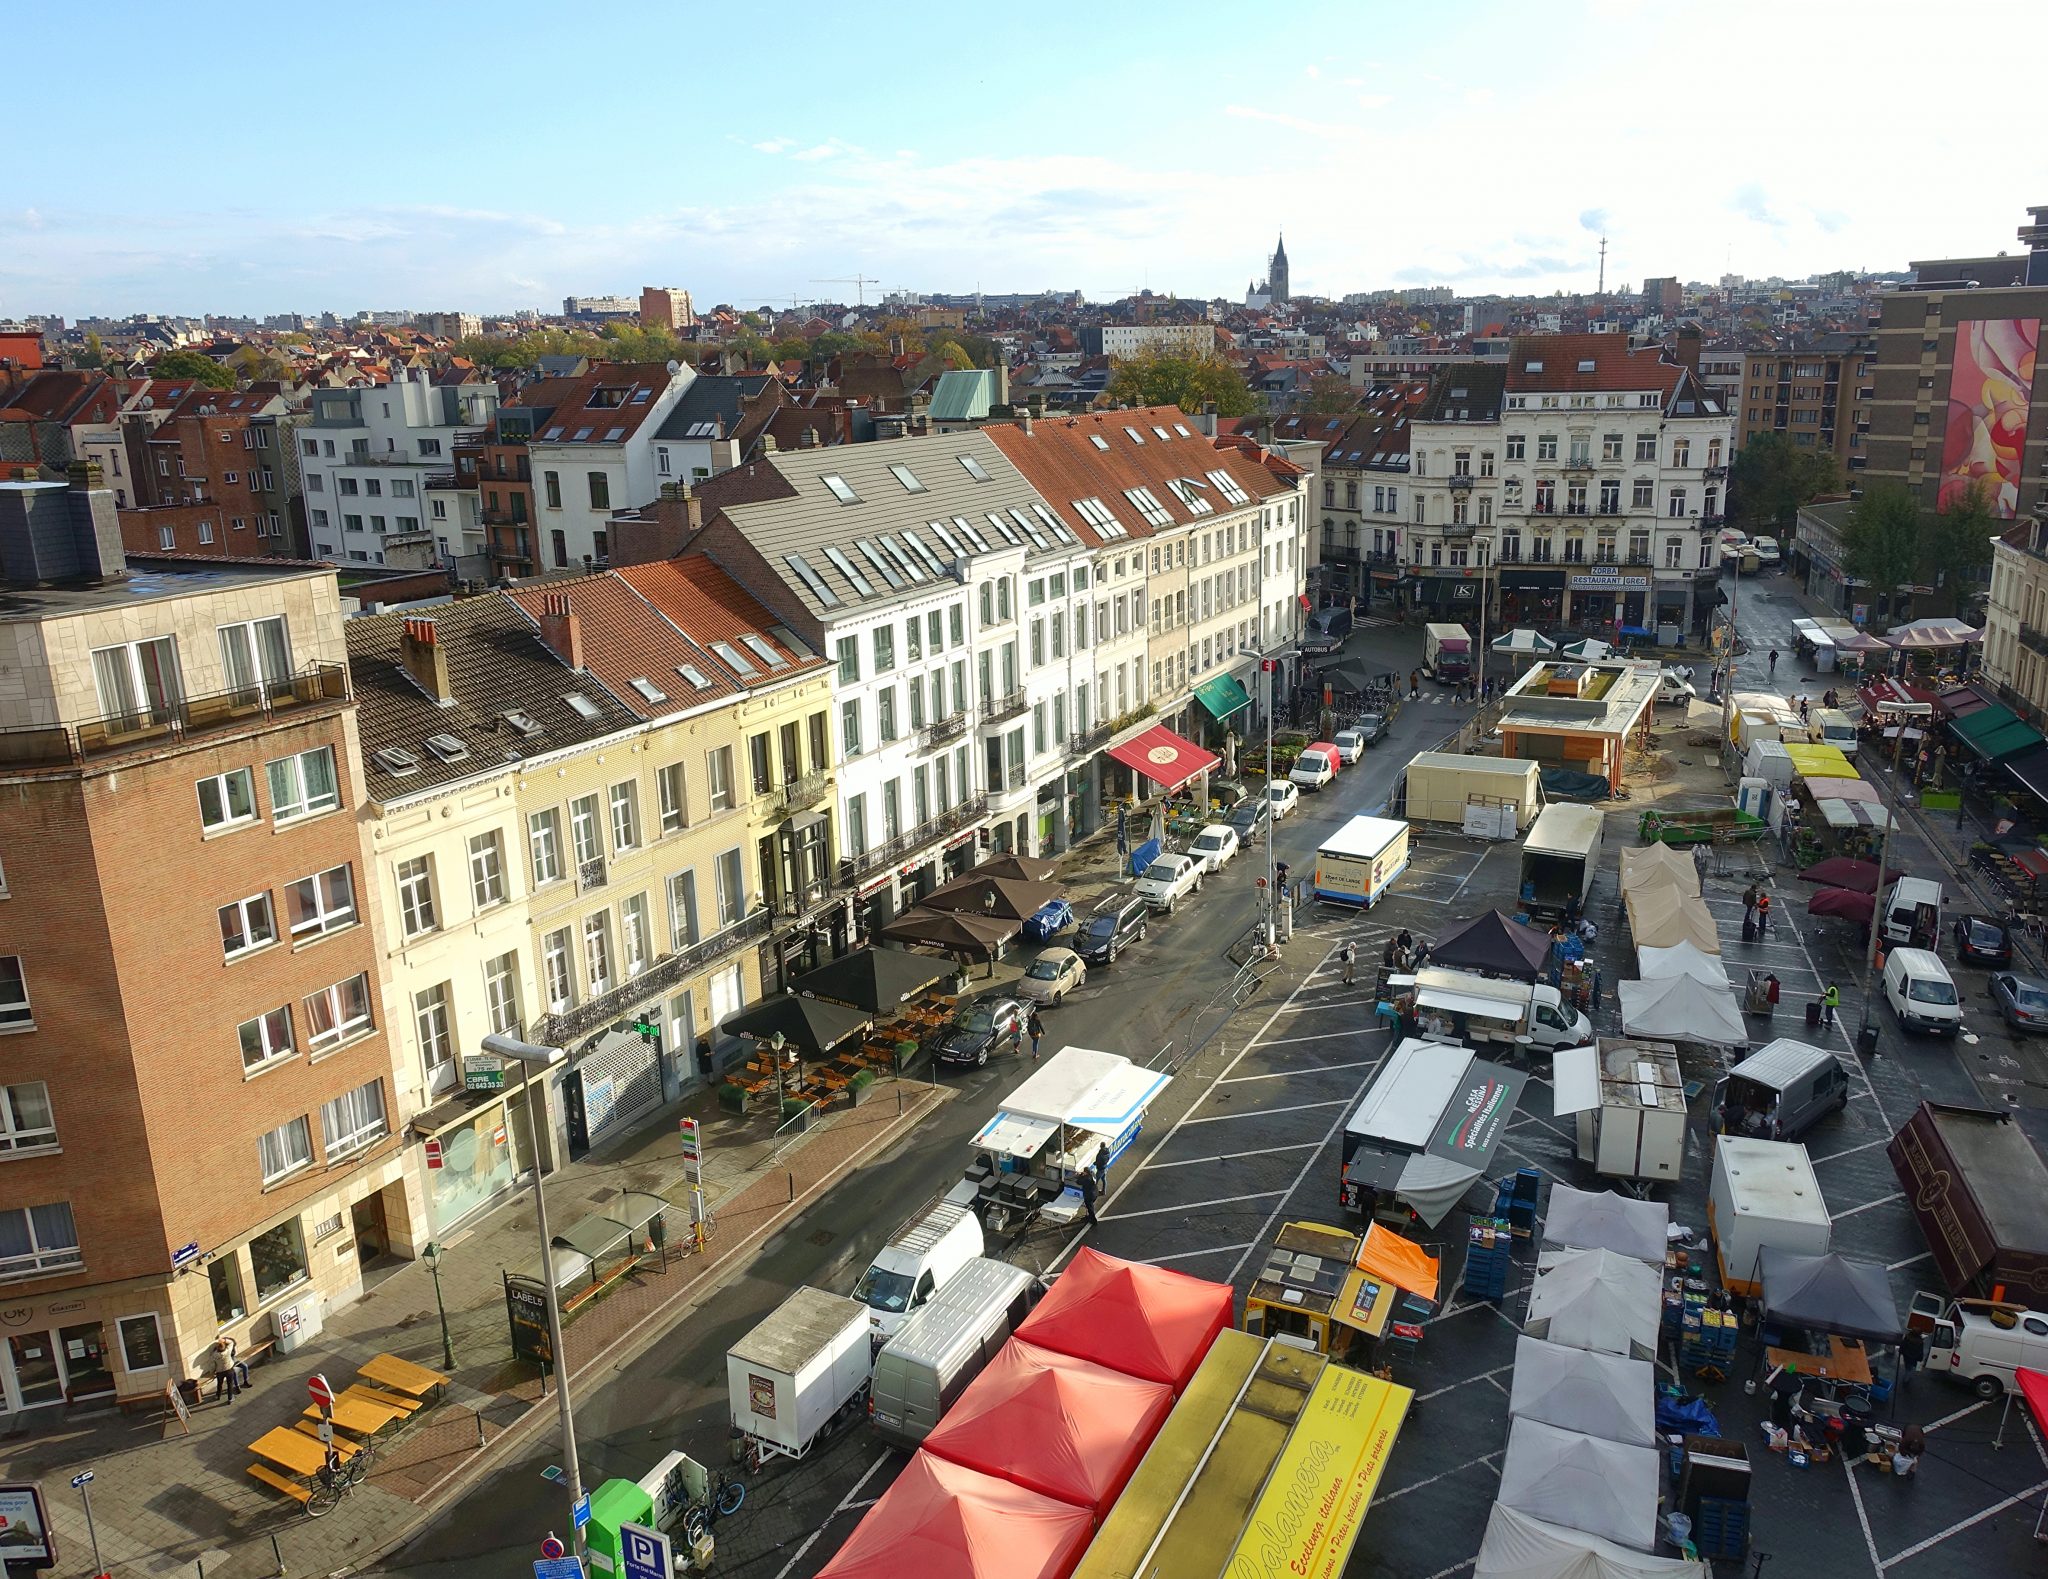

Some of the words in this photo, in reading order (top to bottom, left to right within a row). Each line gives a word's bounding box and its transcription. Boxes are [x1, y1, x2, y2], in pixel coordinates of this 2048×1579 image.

[1572, 577, 1622, 585] RESTAURANT
[1625, 577, 1646, 585] GREC
[1592, 567, 1617, 575] ZORBA
[905, 852, 940, 875] PAMPAS
[920, 939, 945, 948] PAMPAS
[1465, 1089, 1479, 1106] CASA
[1467, 1085, 1487, 1114] MESSINA
[1464, 1113, 1488, 1149] Spécialités
[1482, 1084, 1504, 1116] Italiennes
[511, 1289, 543, 1307] LABEL5
[1358, 1461, 1376, 1483] Plats
[1318, 1475, 1344, 1519] italiana
[634, 1537, 651, 1561] P
